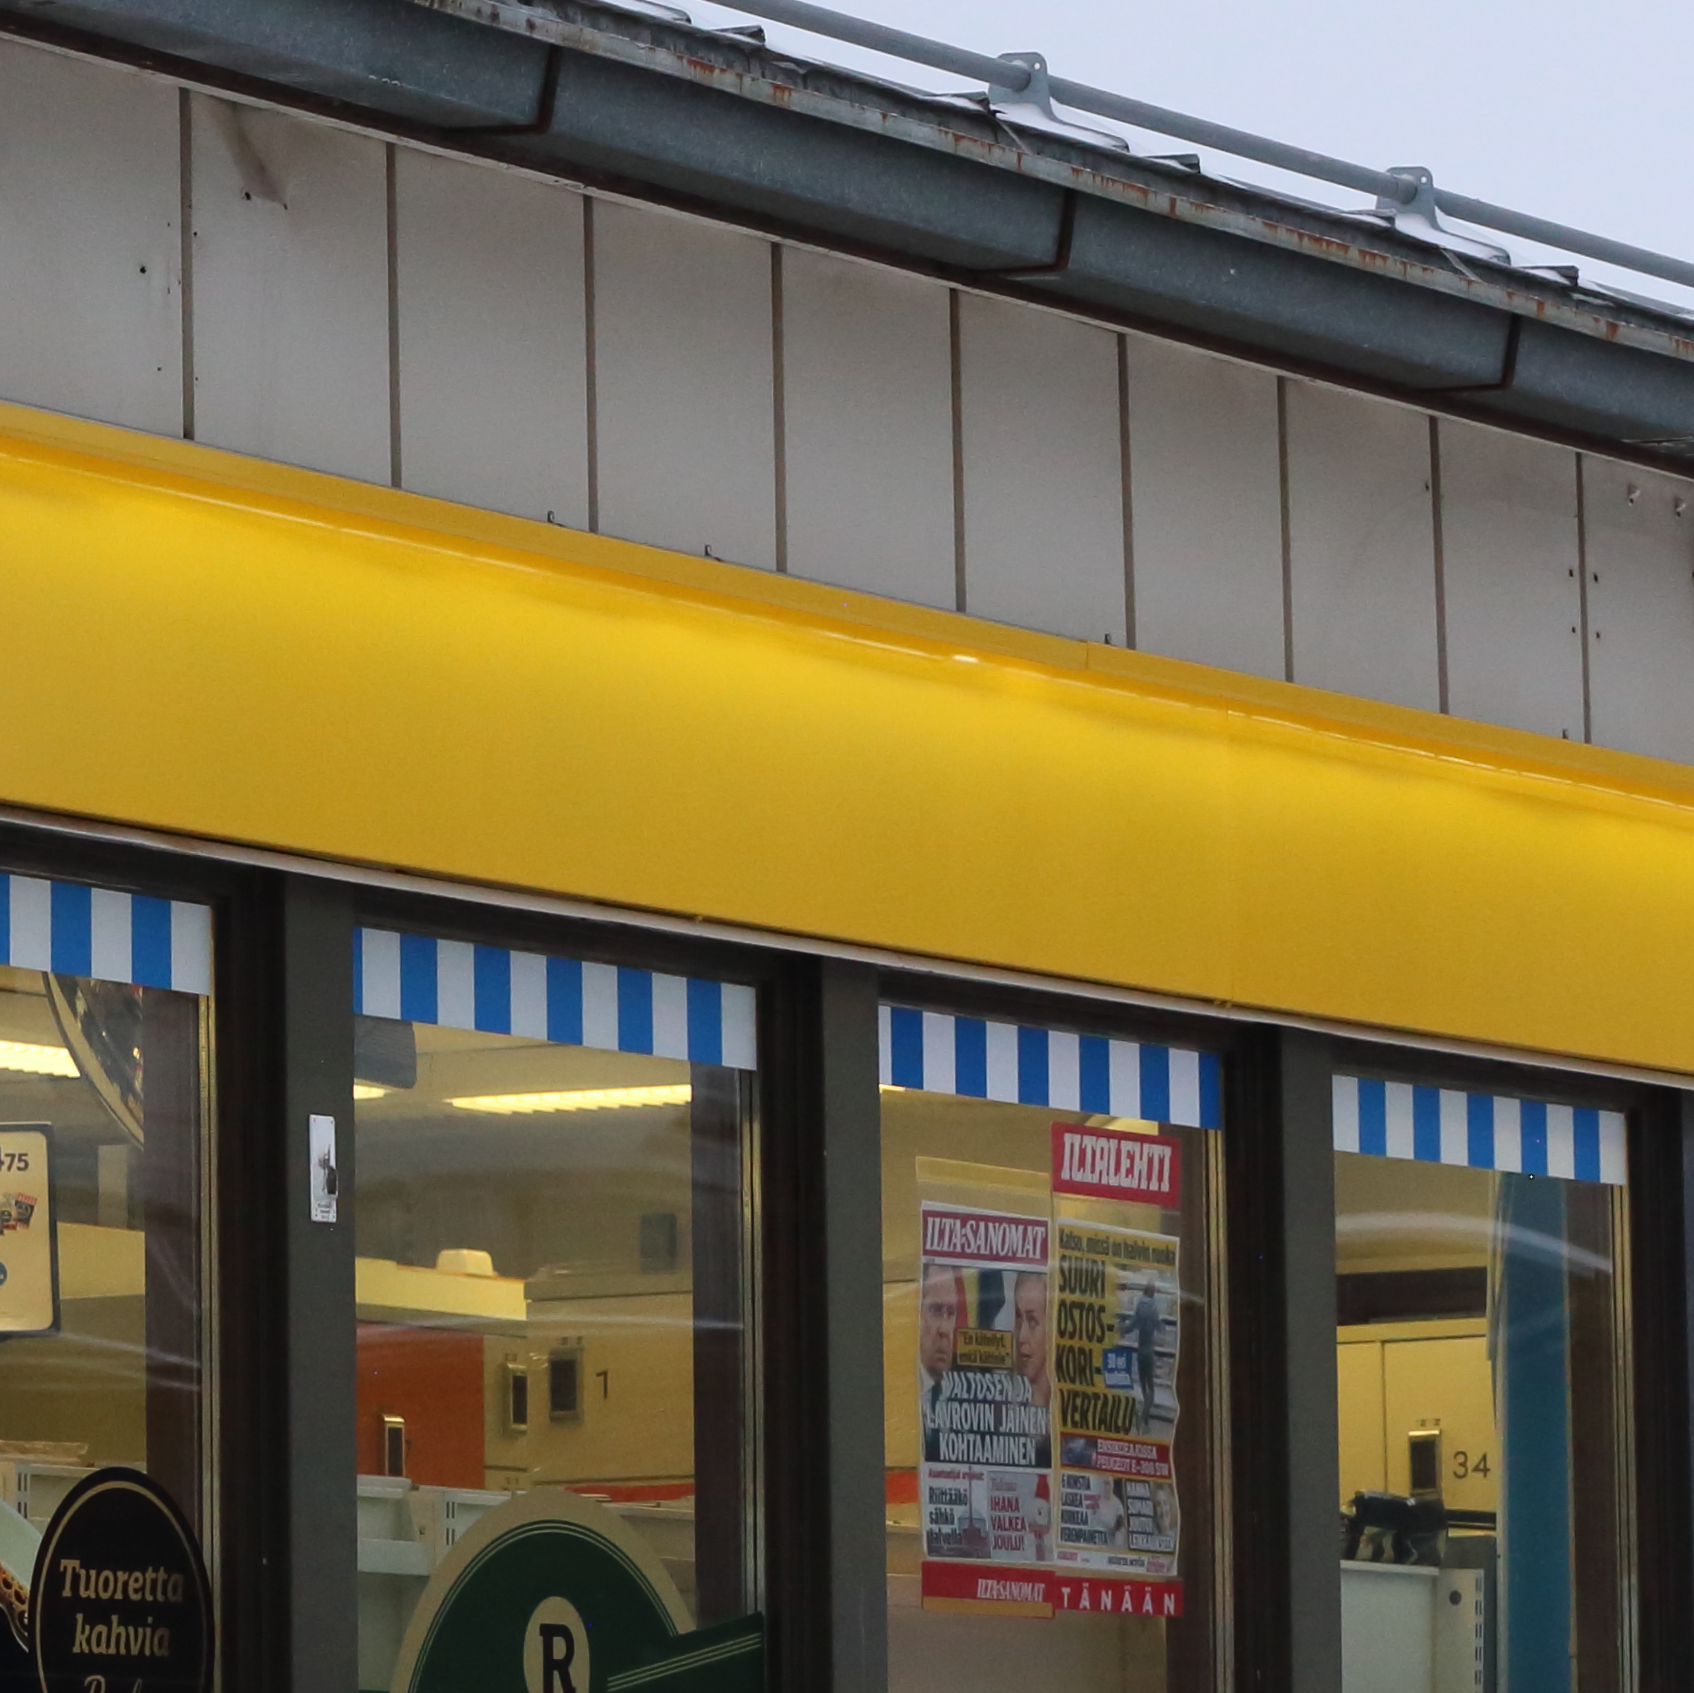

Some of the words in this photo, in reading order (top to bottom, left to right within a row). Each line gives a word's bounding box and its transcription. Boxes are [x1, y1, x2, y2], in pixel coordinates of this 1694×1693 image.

[1060, 1132, 1172, 1193] ILTALEHTI
[1059, 1254, 1106, 1299] SUURI
[1057, 1298, 1115, 1344] OSTOS-
[1055, 1344, 1103, 1387] KORI-
[940, 1371, 1013, 1402] VALTOSEN
[1016, 1374, 1033, 1403] JA
[926, 1401, 994, 1432] LAVROVIN
[1059, 1388, 1137, 1435] VERTAILU
[938, 1432, 1036, 1466] KOHTAAMINEN
[1452, 1450, 1491, 1480] 34
[928, 1485, 968, 1506] Riittääkö
[990, 1495, 1021, 1513] IHANA
[929, 1507, 955, 1526] sähkö
[990, 1514, 1027, 1532] VALKEA
[992, 1533, 1025, 1551] JOULU!
[59, 1559, 184, 1604] Tuoretta
[1061, 1582, 1176, 1616] TÄNÄÄN
[72, 1612, 171, 1657] kahvia
[538, 1622, 576, 1693] R
